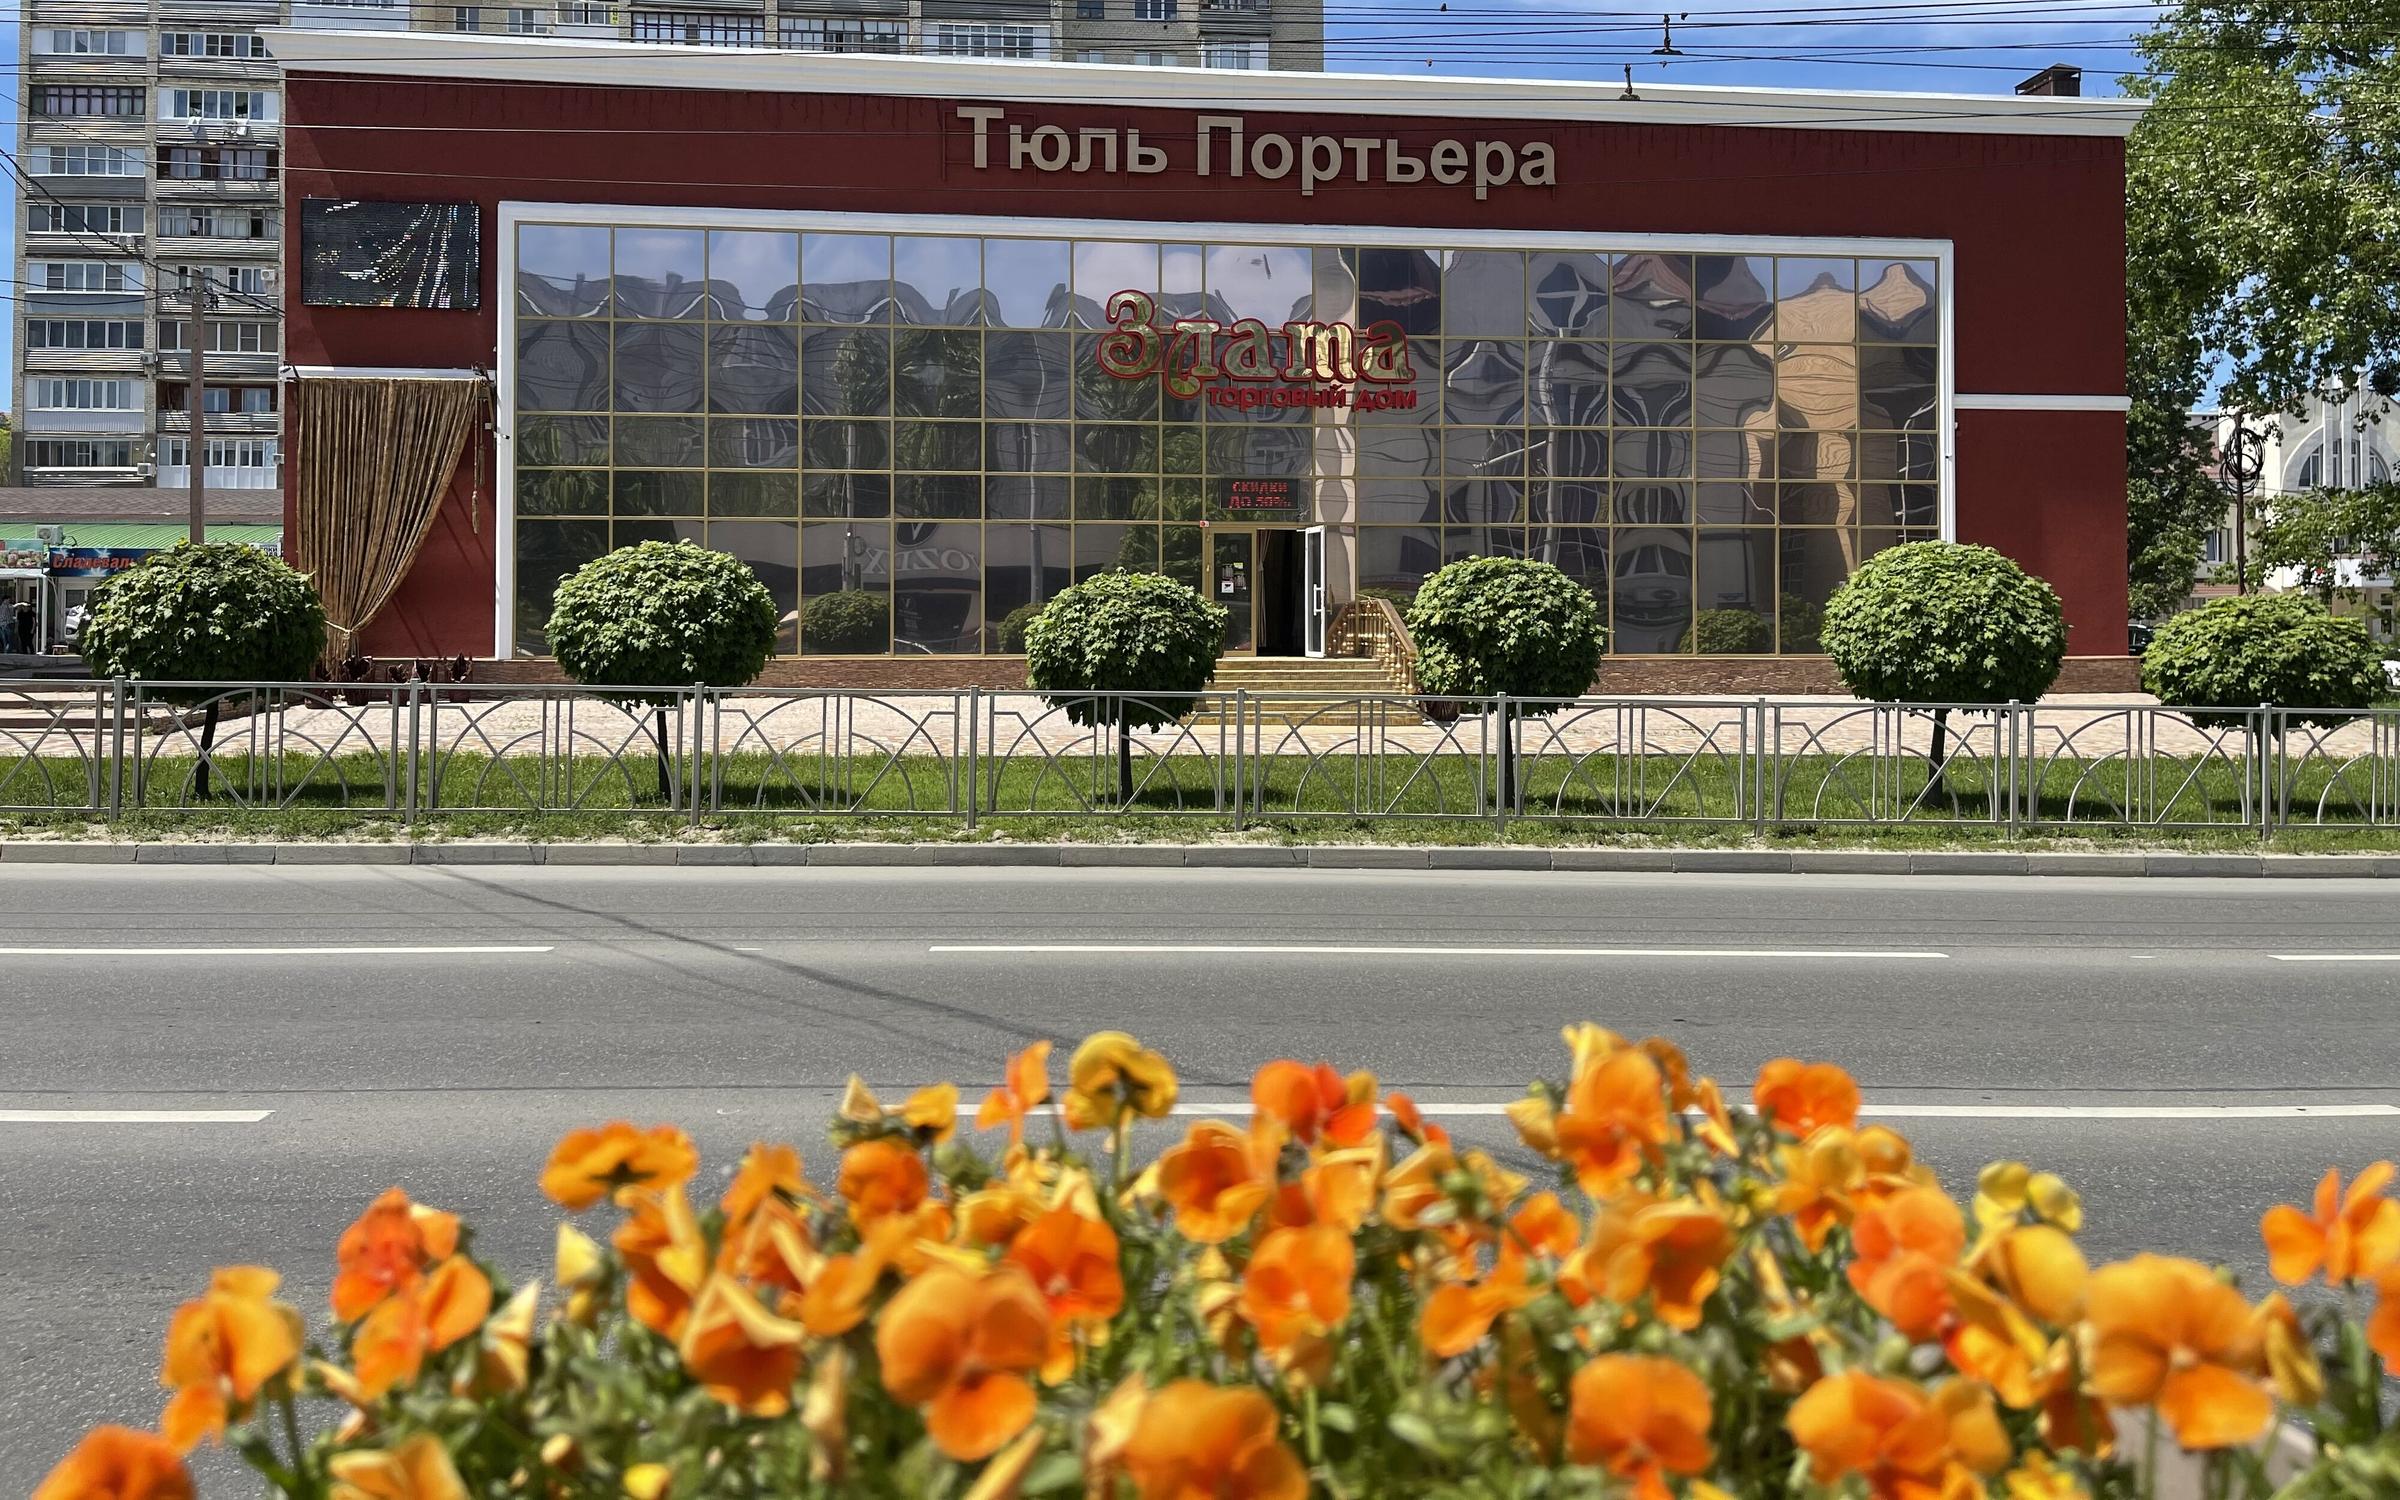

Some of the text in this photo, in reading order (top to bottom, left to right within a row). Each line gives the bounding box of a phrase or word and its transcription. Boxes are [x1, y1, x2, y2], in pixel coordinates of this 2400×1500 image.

[957, 106, 1556, 200] Тюль Портьера
[1097, 289, 1416, 399] Злата
[1207, 384, 1417, 412] торговый дом
[52, 554, 134, 569] Сладевал
